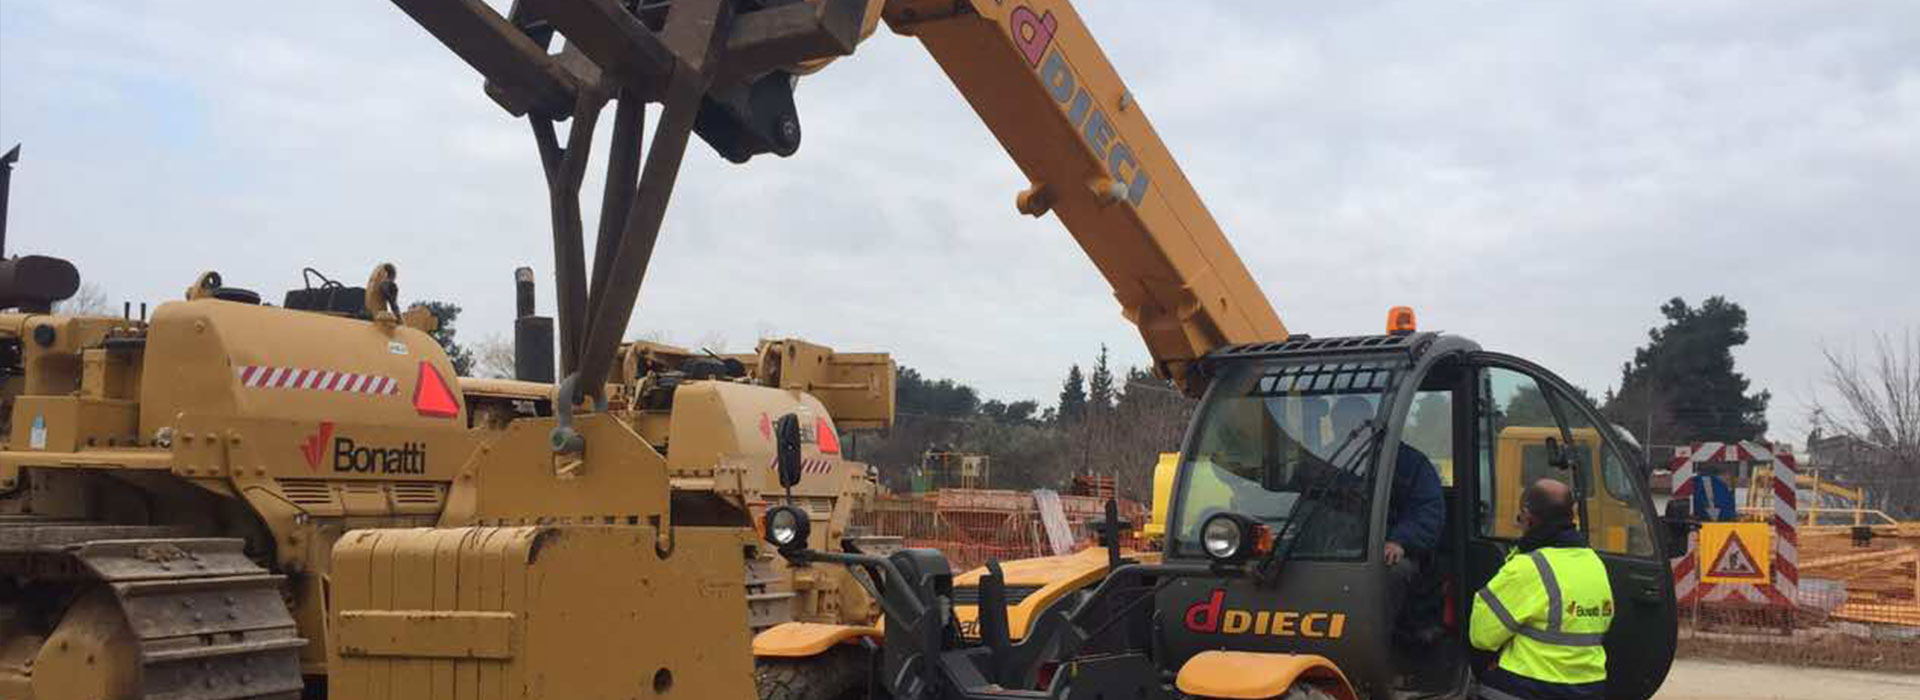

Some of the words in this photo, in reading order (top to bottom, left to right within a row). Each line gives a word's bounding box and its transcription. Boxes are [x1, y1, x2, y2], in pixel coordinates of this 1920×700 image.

[1042, 49, 1149, 207] DIECI
[334, 437, 426, 475] Bonatti
[1222, 609, 1346, 638] DIECI
